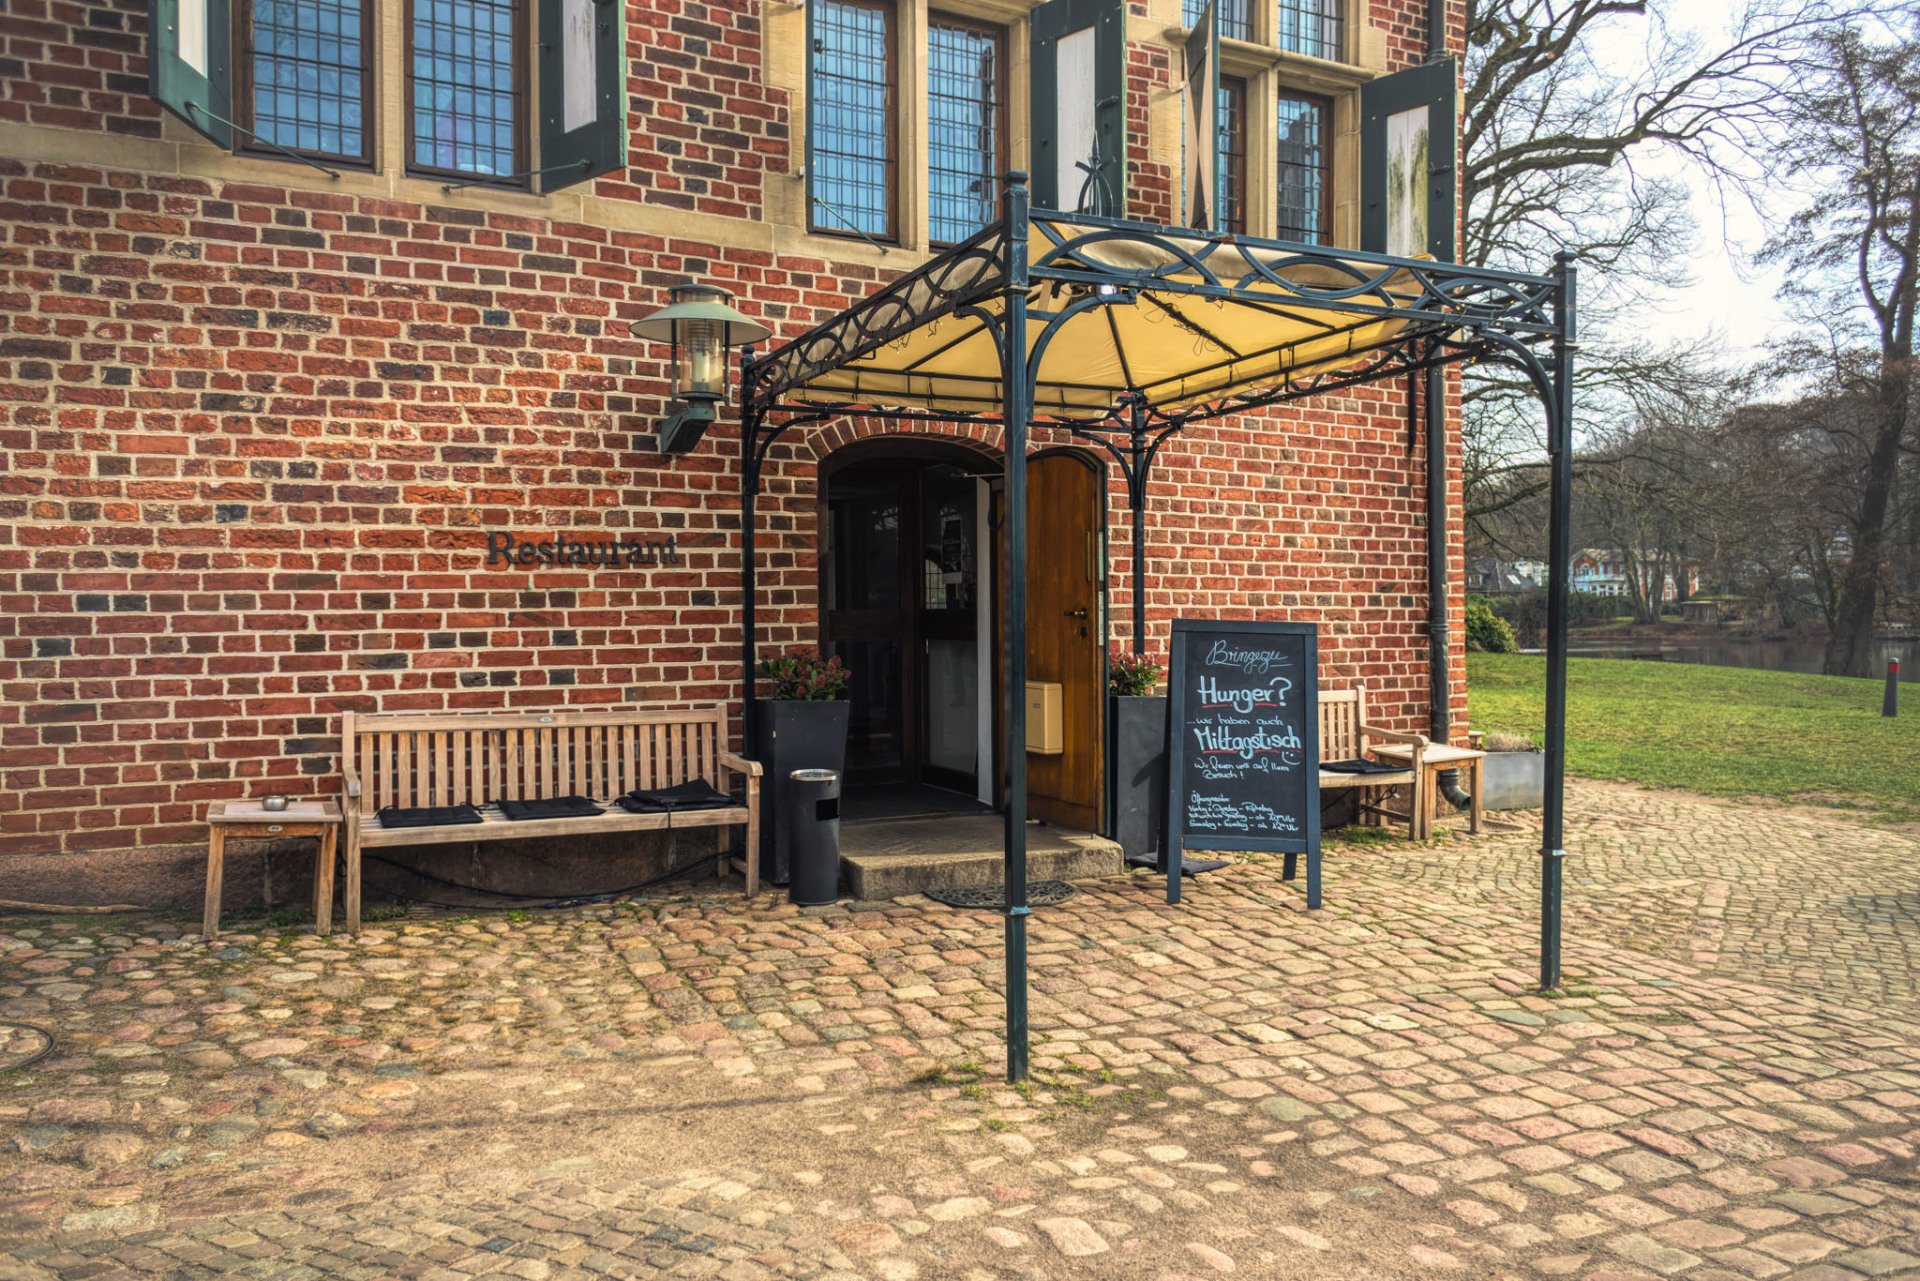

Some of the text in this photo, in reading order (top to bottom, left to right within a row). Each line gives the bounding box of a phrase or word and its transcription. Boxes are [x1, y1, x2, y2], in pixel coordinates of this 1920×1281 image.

[487, 531, 677, 564] Restaurant
[1206, 640, 1289, 674] Bringezu
[1197, 675, 1292, 713] Hunger?
[1218, 713, 1250, 725] haben
[1256, 715, 1284, 726] auch
[1193, 725, 1301, 759] Mittagstisch
[1194, 757, 1208, 769] Wir
[1209, 755, 1234, 772] freuen
[1253, 757, 1269, 774] auf
